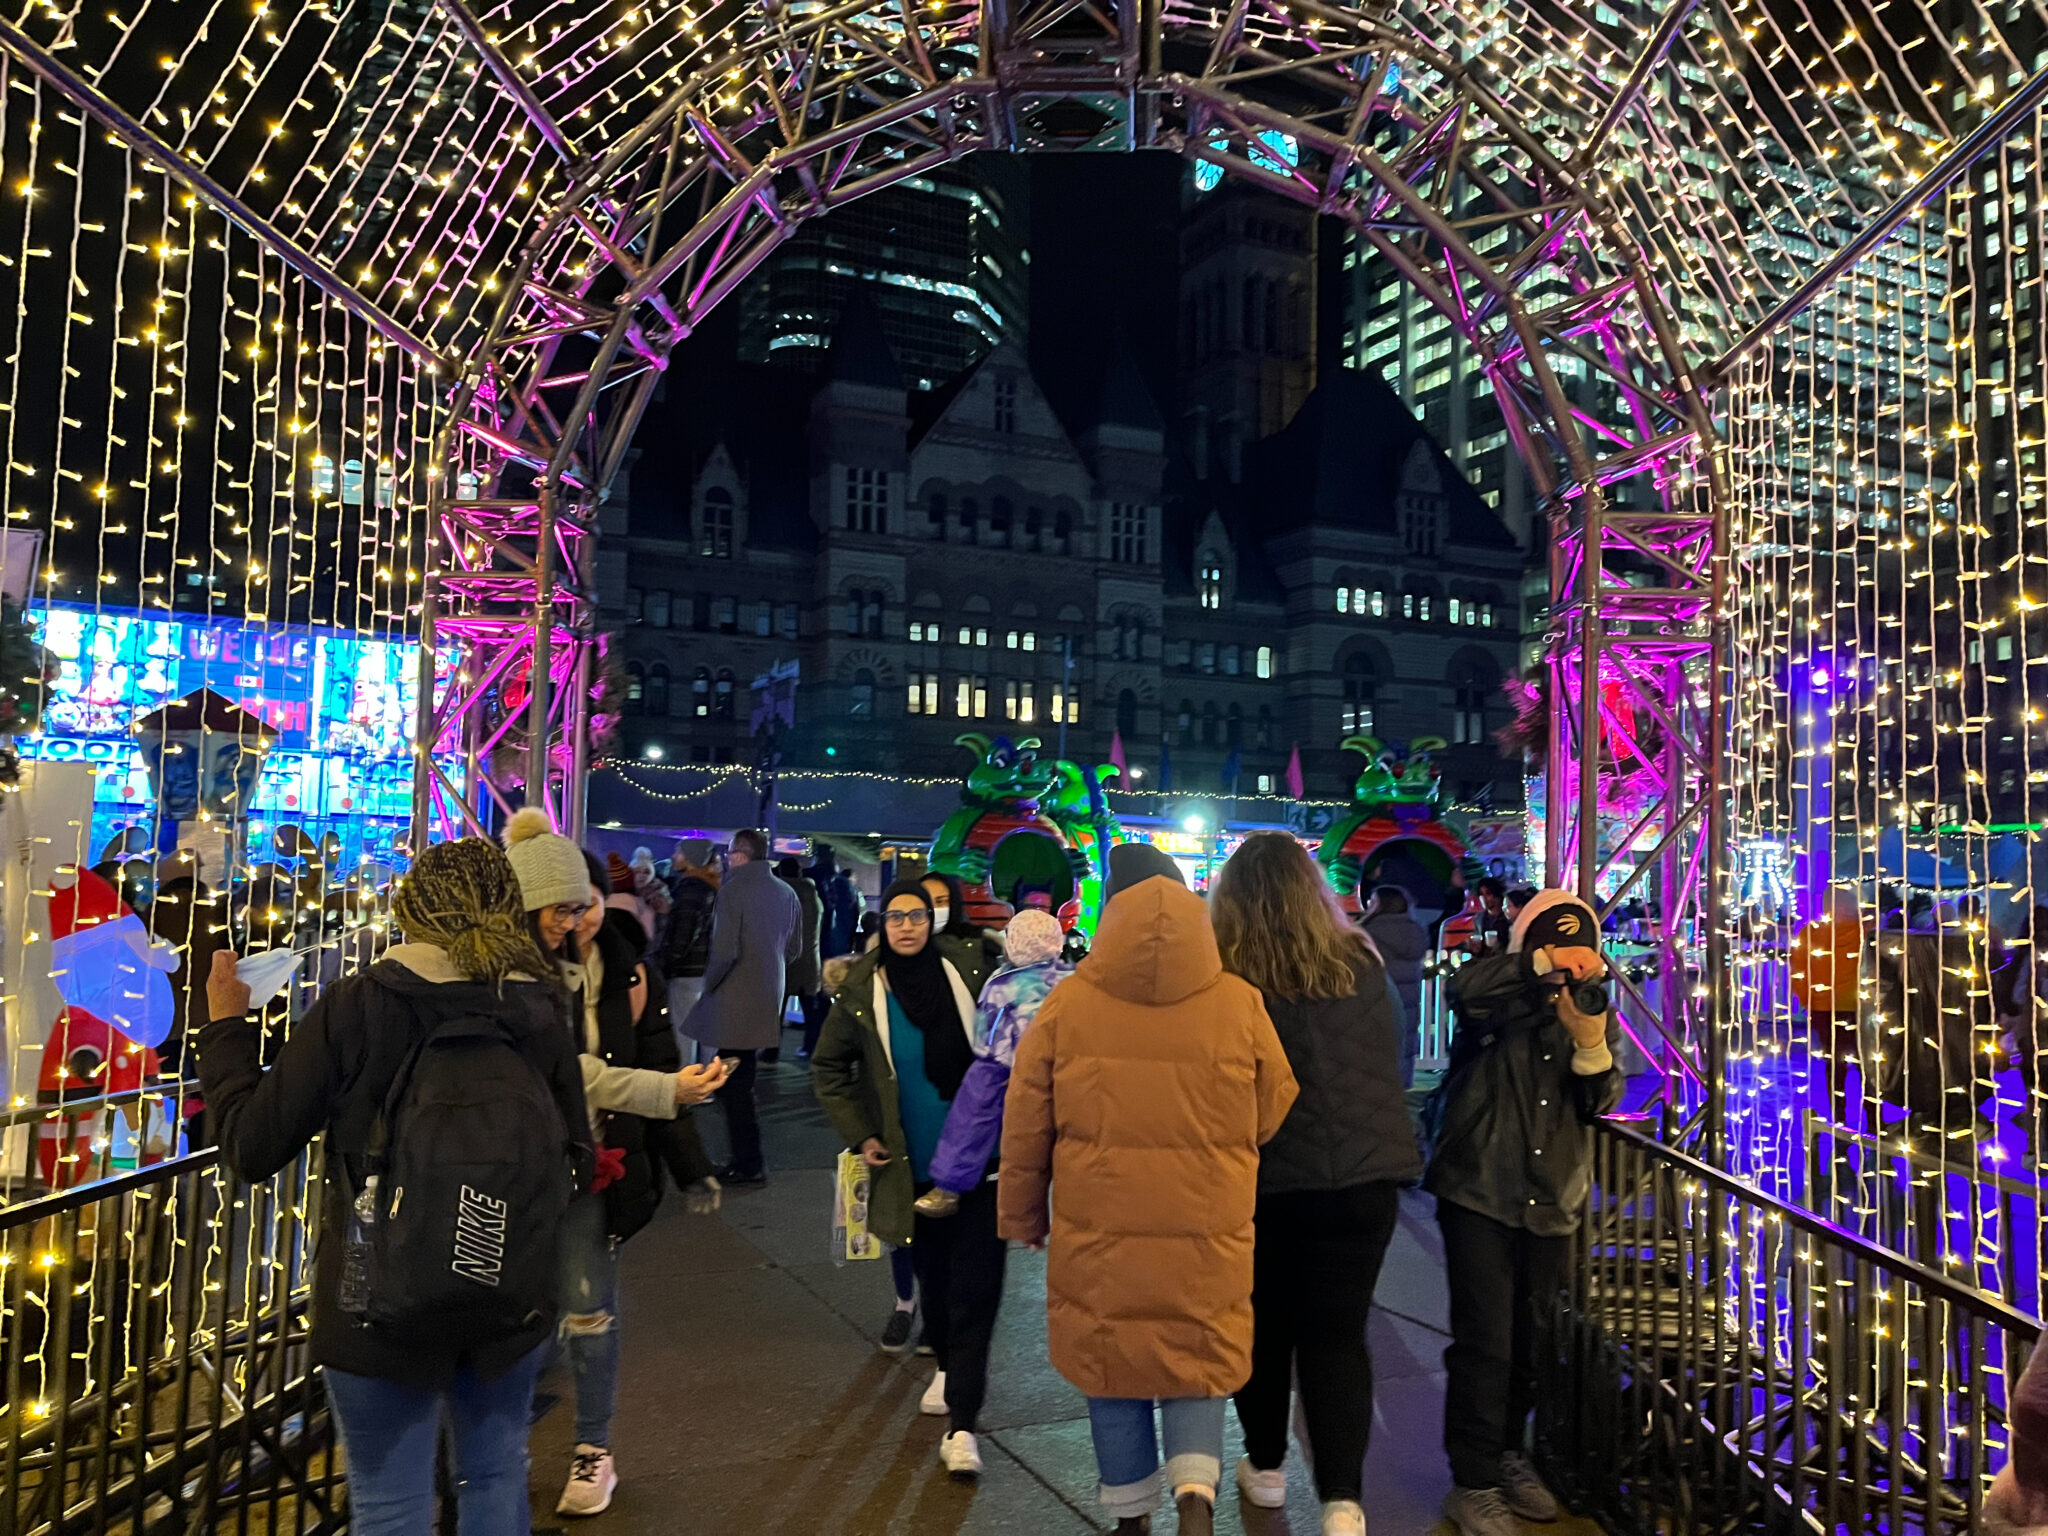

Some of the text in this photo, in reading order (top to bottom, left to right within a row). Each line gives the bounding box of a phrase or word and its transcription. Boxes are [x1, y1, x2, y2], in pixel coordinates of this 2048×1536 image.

[189, 628, 309, 669] WE THE
[222, 697, 306, 732] RTH
[451, 1184, 507, 1287] NIKE
